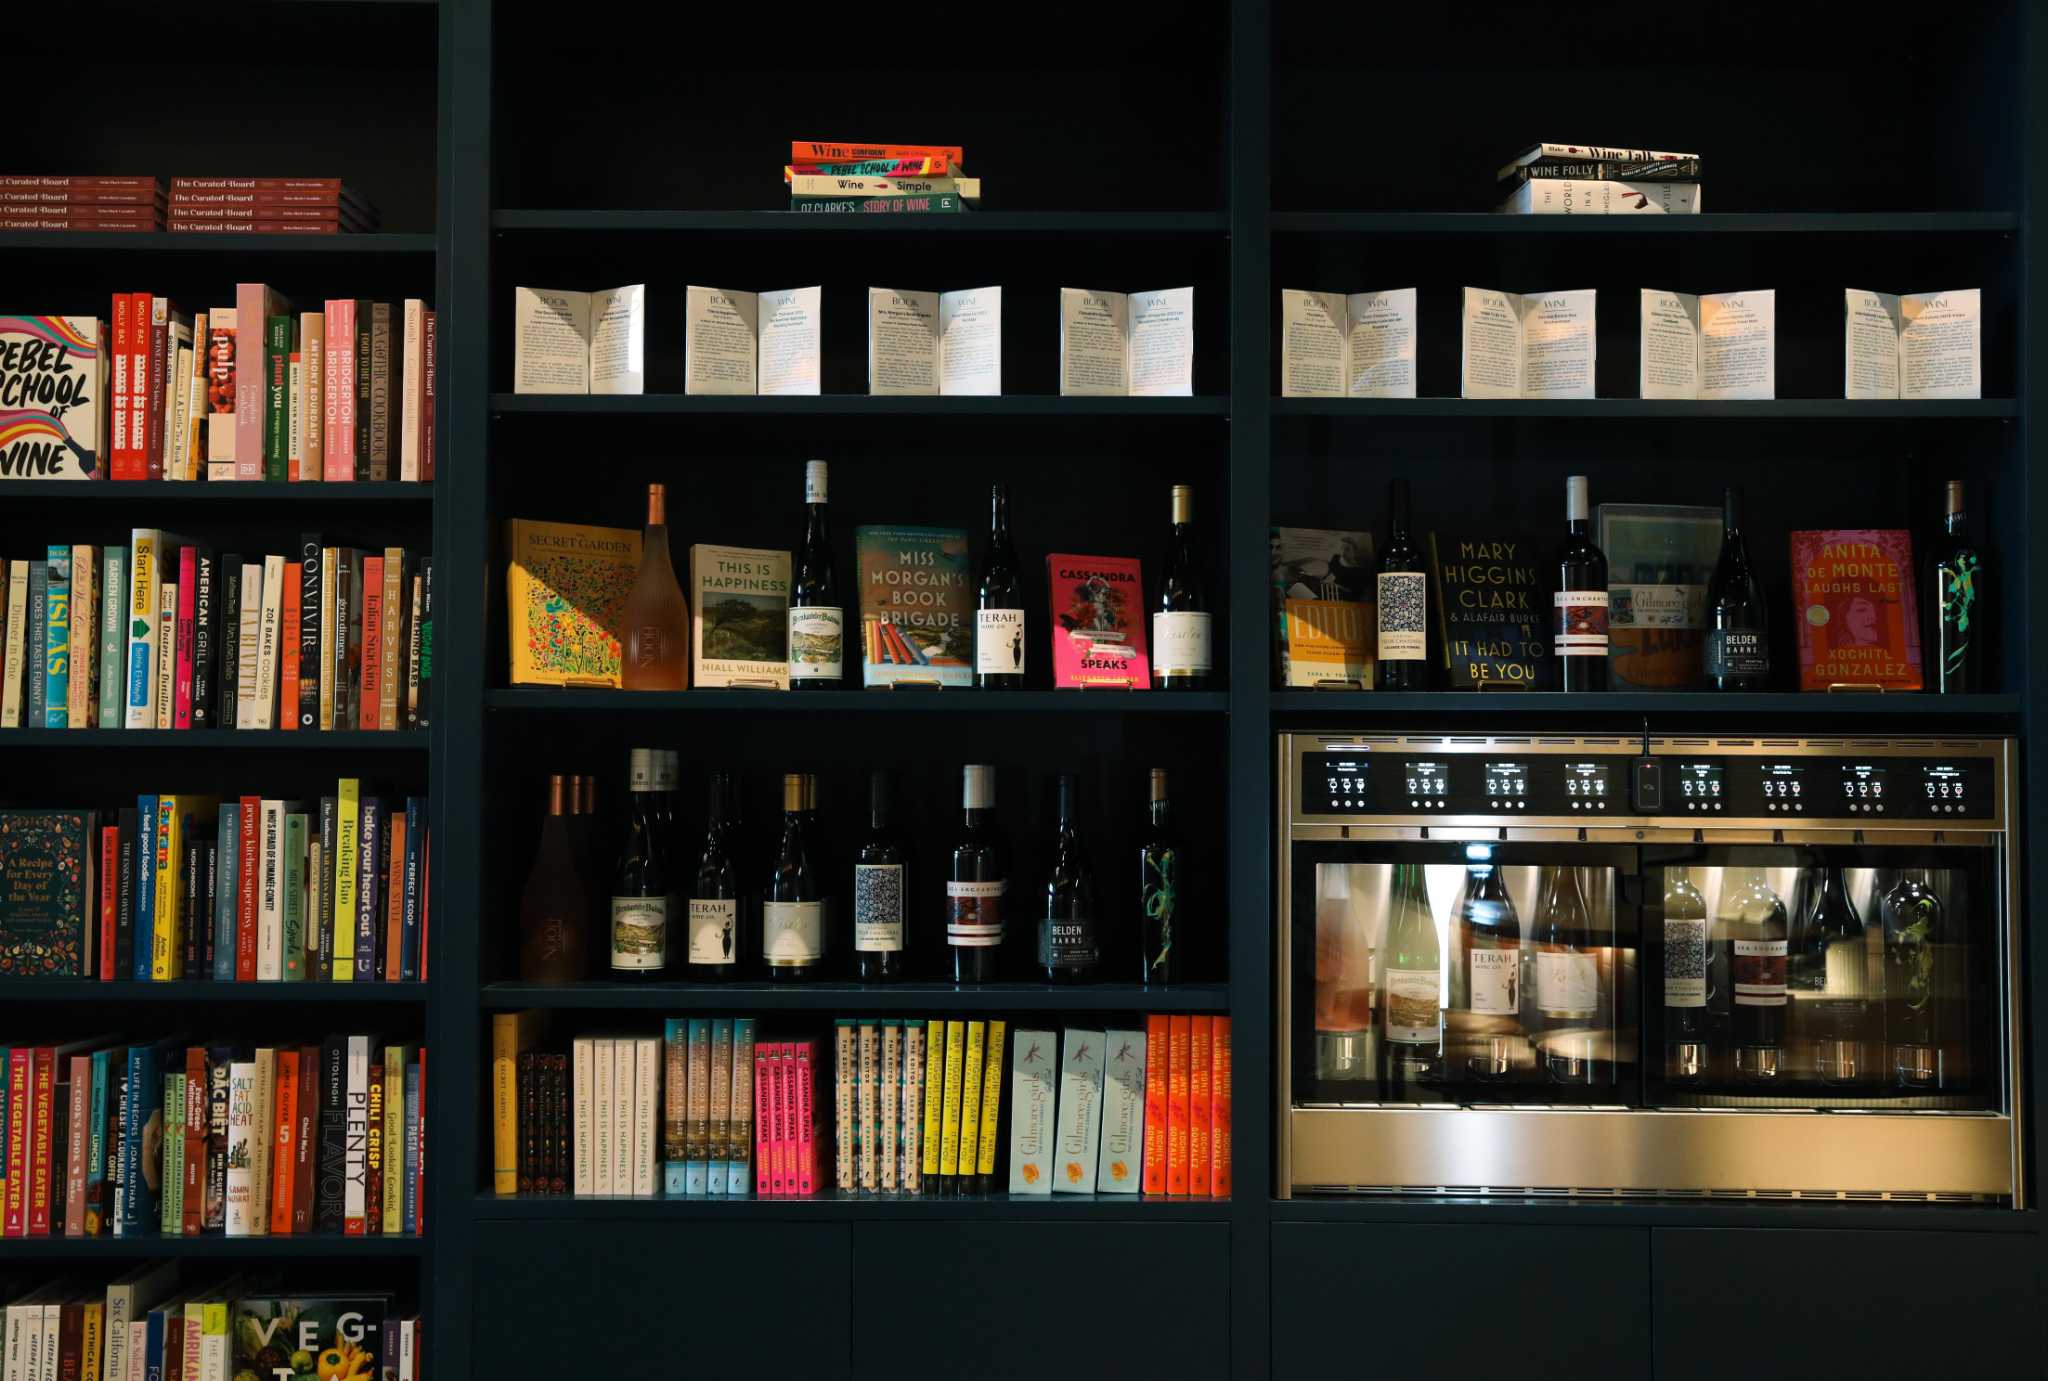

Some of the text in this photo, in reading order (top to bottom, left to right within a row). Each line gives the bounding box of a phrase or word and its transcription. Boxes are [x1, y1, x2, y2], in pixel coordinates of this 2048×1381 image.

[1531, 164, 1595, 177] WINE FOLLY
[1588, 147, 1655, 162] Wine Talk
[194, 194, 254, 203] Curated Board
[196, 180, 256, 189] Curated Board
[838, 179, 932, 192] Wine Simple
[193, 209, 228, 217] Curated
[816, 201, 855, 213] CLARKE'S
[864, 200, 891, 213] STORY
[894, 200, 905, 212] OF
[908, 199, 930, 212] WINE
[193, 224, 227, 232] Curated
[213, 335, 234, 380] pulp
[309, 339, 320, 448] ANTHONY BOURDAIN'S
[326, 351, 339, 424] BRIDGERTON
[340, 350, 353, 424] BRIDGERTON
[50, 406, 70, 421] OF
[372, 387, 387, 457] COOKBOOK
[529, 534, 632, 553] SECRET GARDEN
[899, 551, 935, 566] MISS
[1461, 543, 1517, 561] MARY
[1822, 543, 1882, 560] ANITA
[136, 545, 151, 610] Start Here
[702, 576, 788, 591] HAPPINESS
[720, 561, 771, 576] THIS IS
[871, 570, 964, 587] MORGAN'S
[1060, 569, 1137, 583] CASSANDRA
[1446, 566, 1537, 585] HIGGINS
[1808, 563, 1900, 579] DE MONTE
[107, 559, 119, 632] GARDEN GROWN
[302, 542, 319, 649] CONVIVIR
[892, 591, 947, 607] BOOK
[1460, 591, 1529, 609] CLARK
[1803, 582, 1905, 594] LAUGHS LAST
[196, 557, 211, 667] AMERICAN GRILL
[366, 594, 380, 632] Italian
[880, 611, 960, 628] BRIGADE
[980, 613, 1017, 623] TERAH
[8, 604, 24, 680] Dinner in One
[32, 595, 43, 705] DOES THIS TASTE FUNNY?
[48, 593, 70, 676] ISLAS
[162, 625, 173, 657] Doctors
[337, 625, 349, 660] dinners
[1456, 641, 1545, 658] IT HAD TO
[1727, 635, 1758, 645] BELDEN
[259, 607, 276, 700] ZOË BAKES cookies
[1080, 658, 1129, 671] SPEAKS
[1828, 650, 1893, 662] XOCHITL
[410, 659, 419, 688] BARS
[702, 664, 788, 676] NIALL WILLIAMS
[1471, 663, 1536, 680] BE YOU
[1814, 663, 1908, 678] GONZALEZ
[159, 674, 172, 715] Distillers
[244, 803, 256, 877] preppy kitchen
[339, 820, 355, 905] Breaking Bao
[361, 806, 376, 937] bake your heart out
[407, 862, 417, 926] PERFECT SCOOP
[689, 904, 727, 913] TERAH
[1053, 926, 1082, 936] BELDEN
[1473, 953, 1513, 964] TERAH
[231, 1078, 254, 1089] SALT
[331, 1049, 340, 1106] OTTOLENGHI
[131, 1057, 141, 1136] MY LIFE IN RECIPES
[232, 1090, 253, 1102] FAT
[232, 1103, 253, 1114] ACID
[787, 1065, 795, 1141] CASSANDRA SPEAKS
[802, 1067, 810, 1143] CASSANDRA SPEAKS
[73, 1089, 83, 1162] COOK'S BOOK
[231, 1114, 254, 1127] HEAT
[368, 1083, 382, 1169] CHILI CRISP
[1020, 1072, 1044, 1156] Gilmore girls
[1065, 1071, 1091, 1156] Gilmore girls
[1109, 1070, 1135, 1155] Gilmore girls
[10, 1065, 24, 1208] THE VEGETABLE EATER
[35, 1064, 49, 1208] THE VEGETABLE EATER
[346, 1092, 367, 1186] PLENTY
[578, 1100, 587, 1179] THIS IS HAPPINESS
[599, 1100, 608, 1179] THIS IS HAPPINESS
[619, 1100, 628, 1179] THIS IS HAPPINESS
[639, 1100, 649, 1179] THIS IS HAPPINESS
[91, 1133, 100, 1172] LUNCHES
[107, 1153, 117, 1182] COFFEE
[320, 1109, 346, 1218] FLAVOR
[128, 1145, 139, 1209] JOAN NATHAN
[86, 1322, 97, 1368] MYTHICAL
[110, 1298, 126, 1378] Six California
[131, 1346, 142, 1372] Salad
